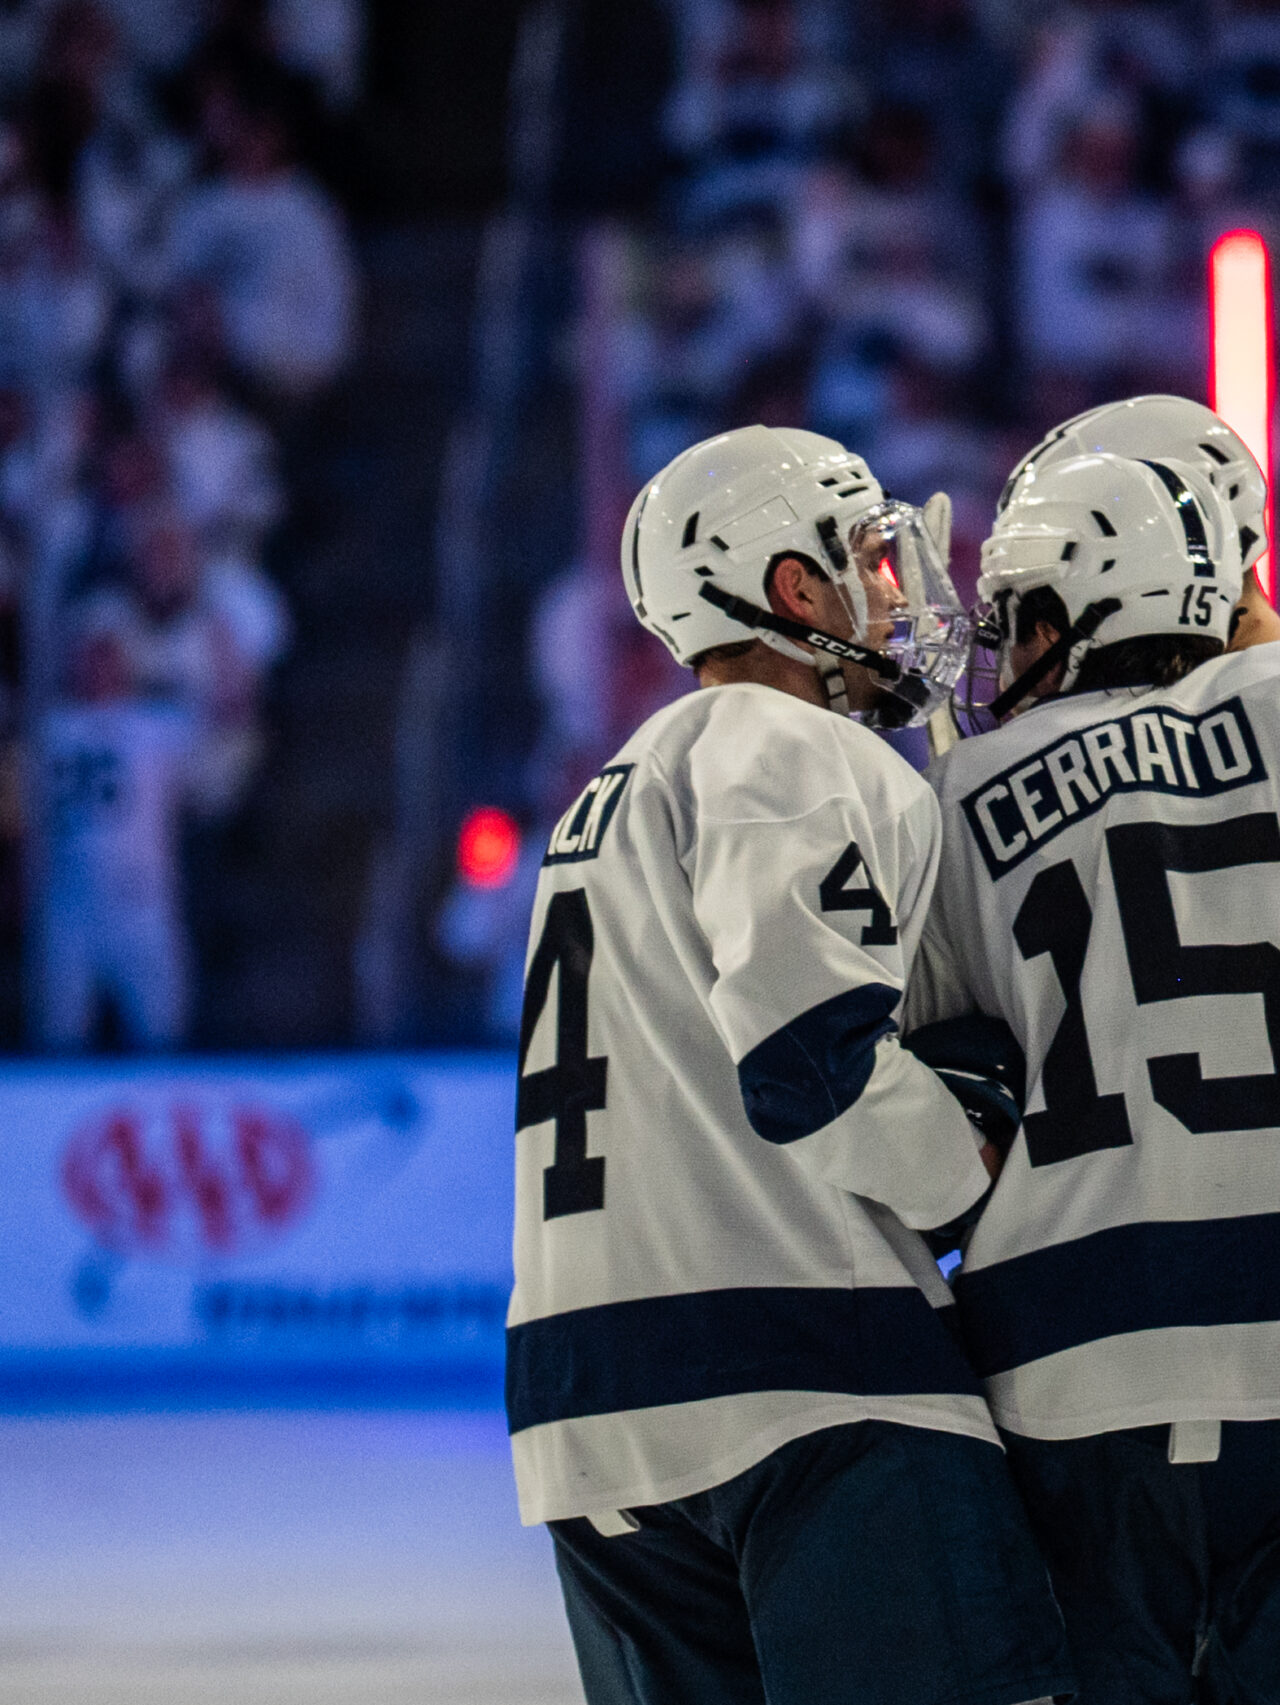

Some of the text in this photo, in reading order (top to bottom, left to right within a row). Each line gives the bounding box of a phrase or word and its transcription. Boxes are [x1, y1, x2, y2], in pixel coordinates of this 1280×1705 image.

[807, 632, 867, 661] CCM
[1178, 584, 1218, 627] 15
[974, 710, 1252, 862] CERRATO
[819, 840, 899, 946] 4
[515, 887, 609, 1222] 4
